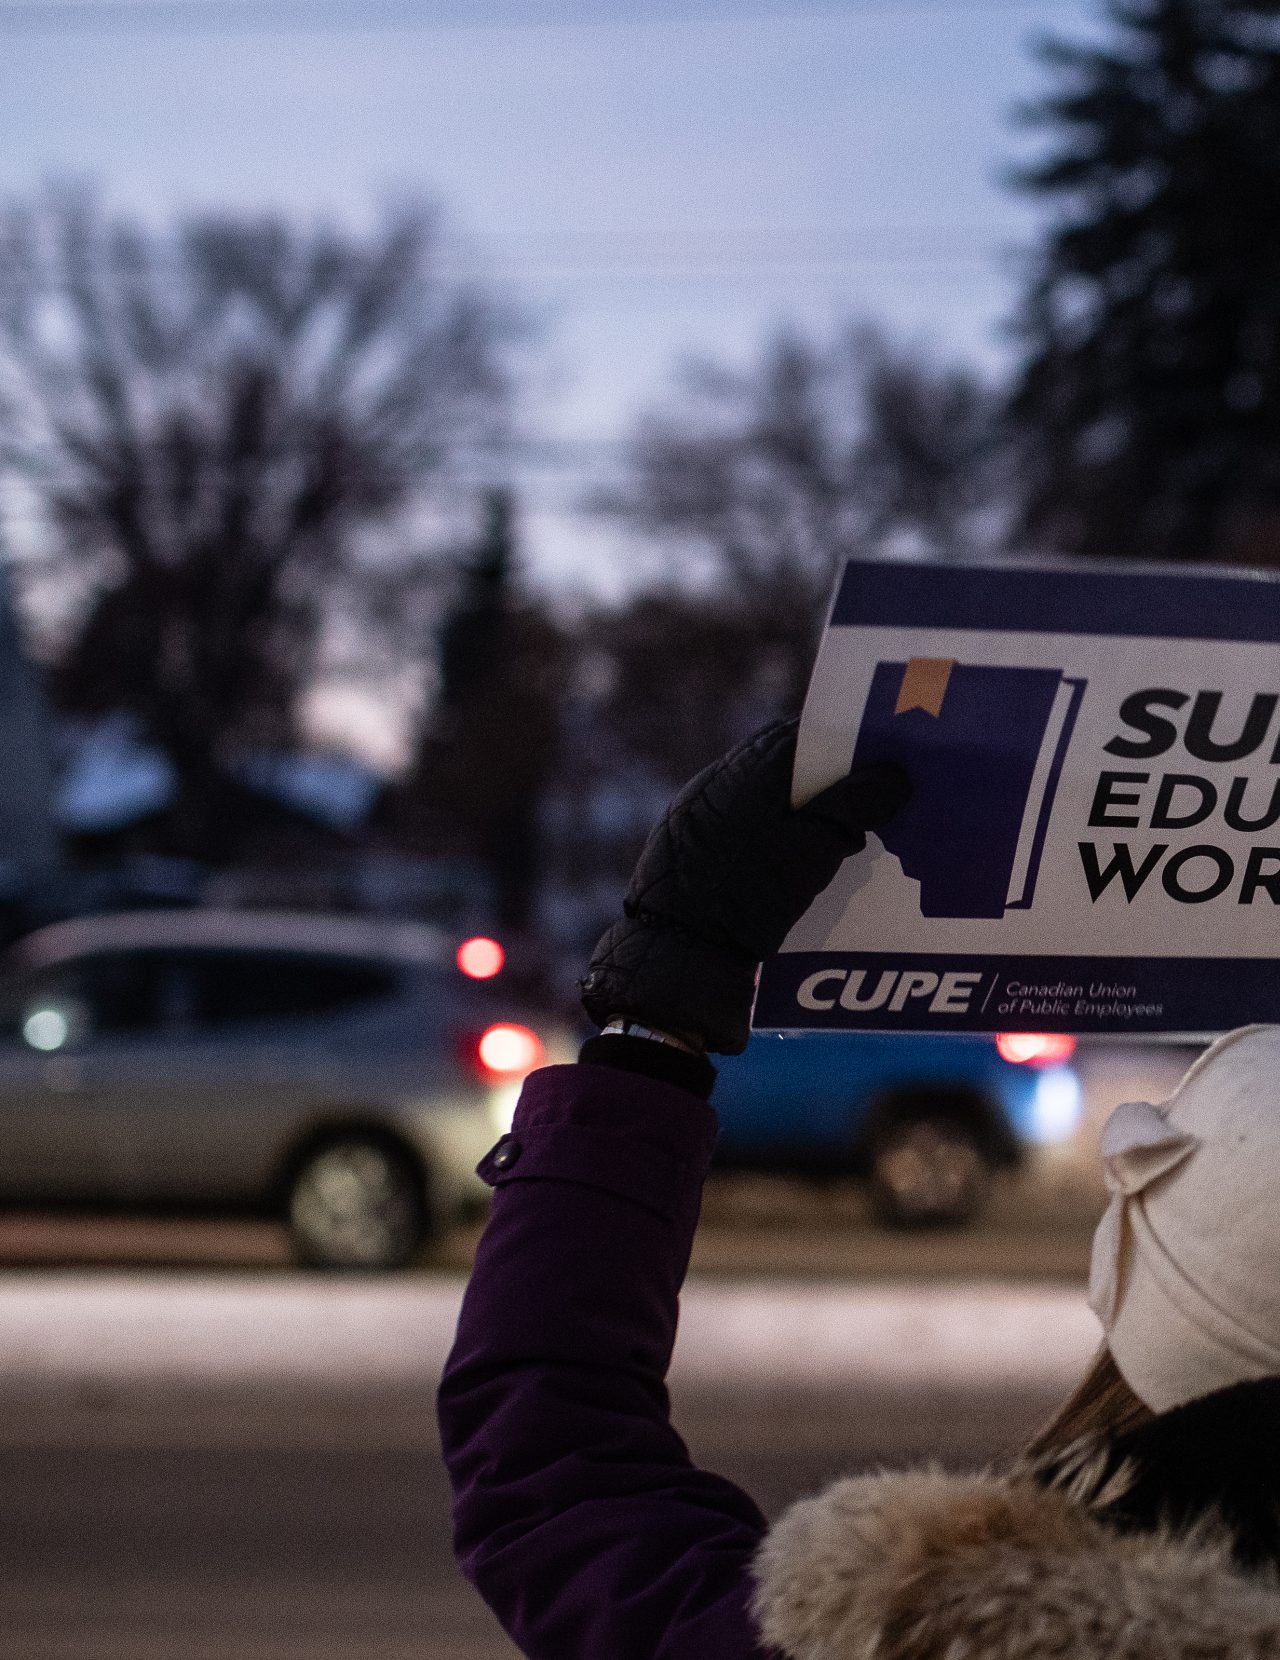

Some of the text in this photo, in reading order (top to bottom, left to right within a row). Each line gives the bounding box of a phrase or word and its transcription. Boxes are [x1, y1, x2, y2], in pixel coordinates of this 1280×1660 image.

[796, 968, 982, 1014] CUPE
[1006, 981, 1137, 998] Canadian Union
[998, 998, 1163, 1019] of Public Employees
